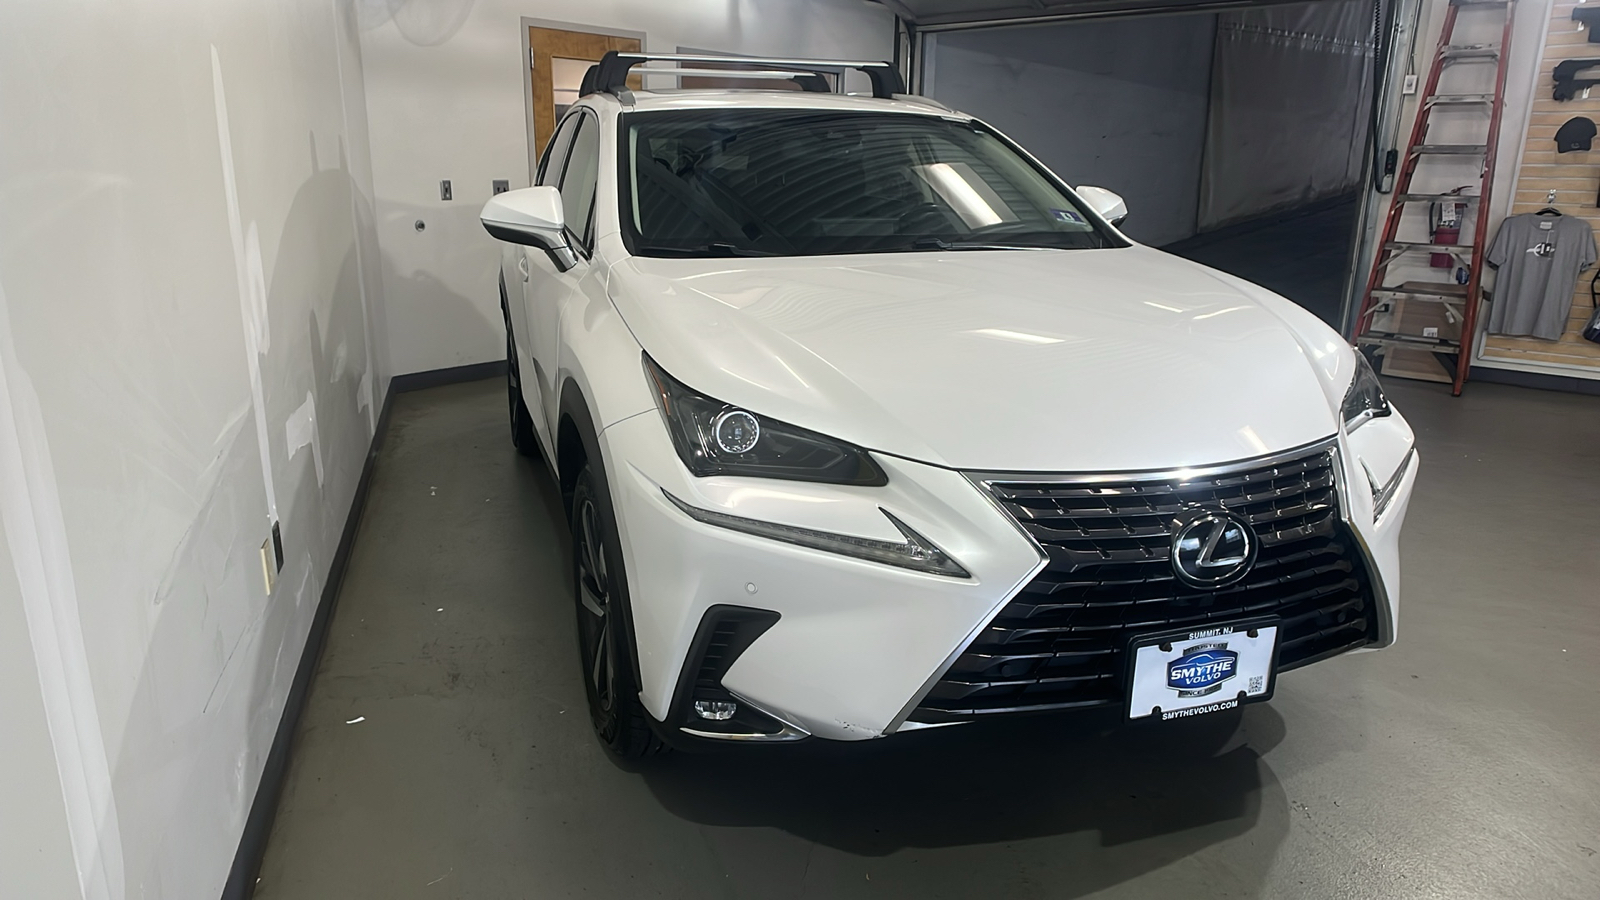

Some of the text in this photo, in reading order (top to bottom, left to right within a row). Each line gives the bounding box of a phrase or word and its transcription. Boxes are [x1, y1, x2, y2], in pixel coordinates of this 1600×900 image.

[1222, 626, 1234, 635] NJ
[1171, 661, 1231, 680] SMYTHE
[1185, 672, 1221, 685] VOLVO
[1162, 700, 1238, 720] SMYTHEVOLVO.COM
